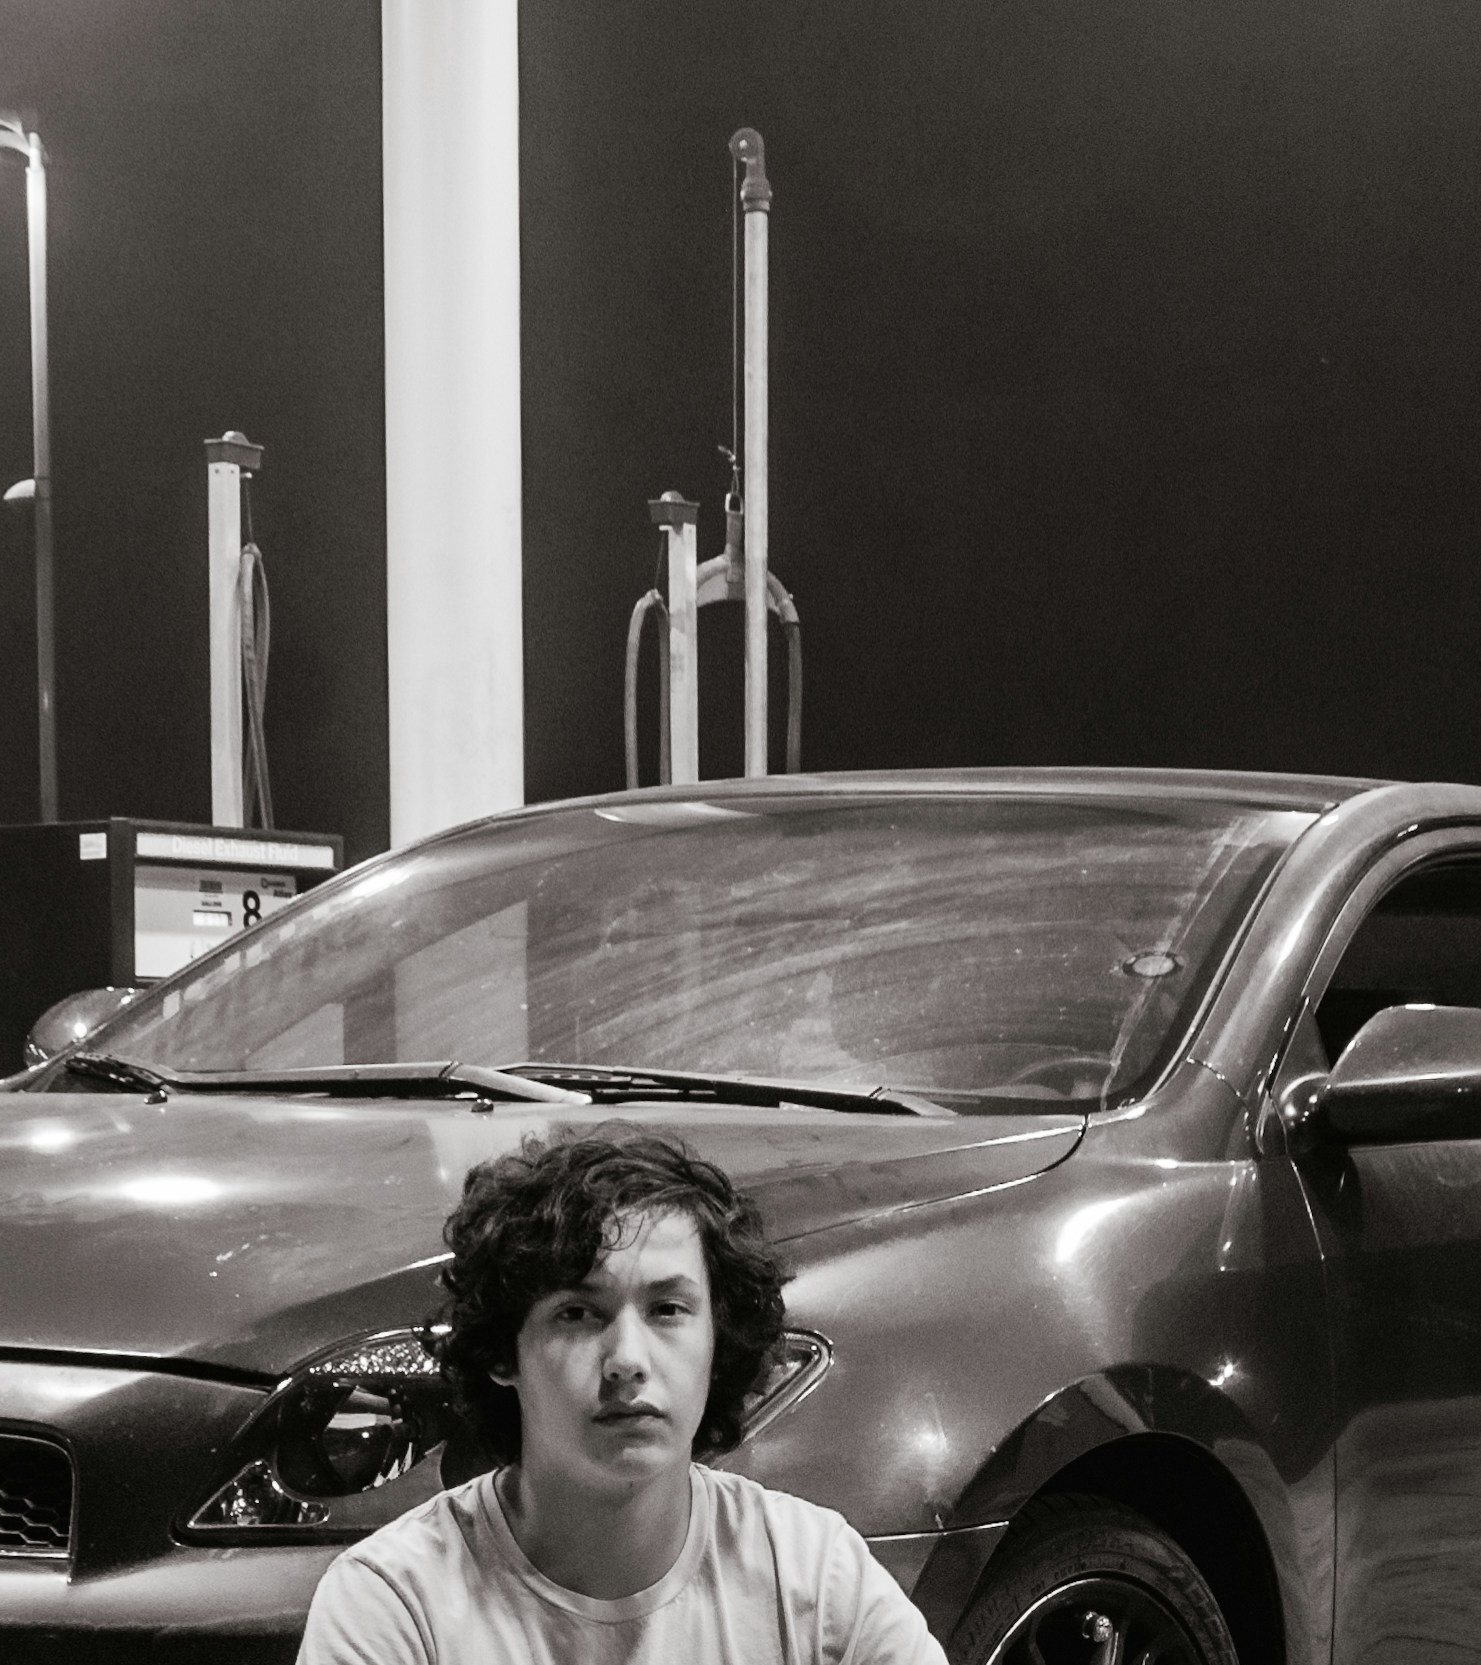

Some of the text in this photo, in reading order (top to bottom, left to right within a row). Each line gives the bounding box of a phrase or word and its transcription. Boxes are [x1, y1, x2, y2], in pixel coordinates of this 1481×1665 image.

[172, 835, 298, 860] Diesel Exhaust Fluid
[243, 890, 261, 928] 8
